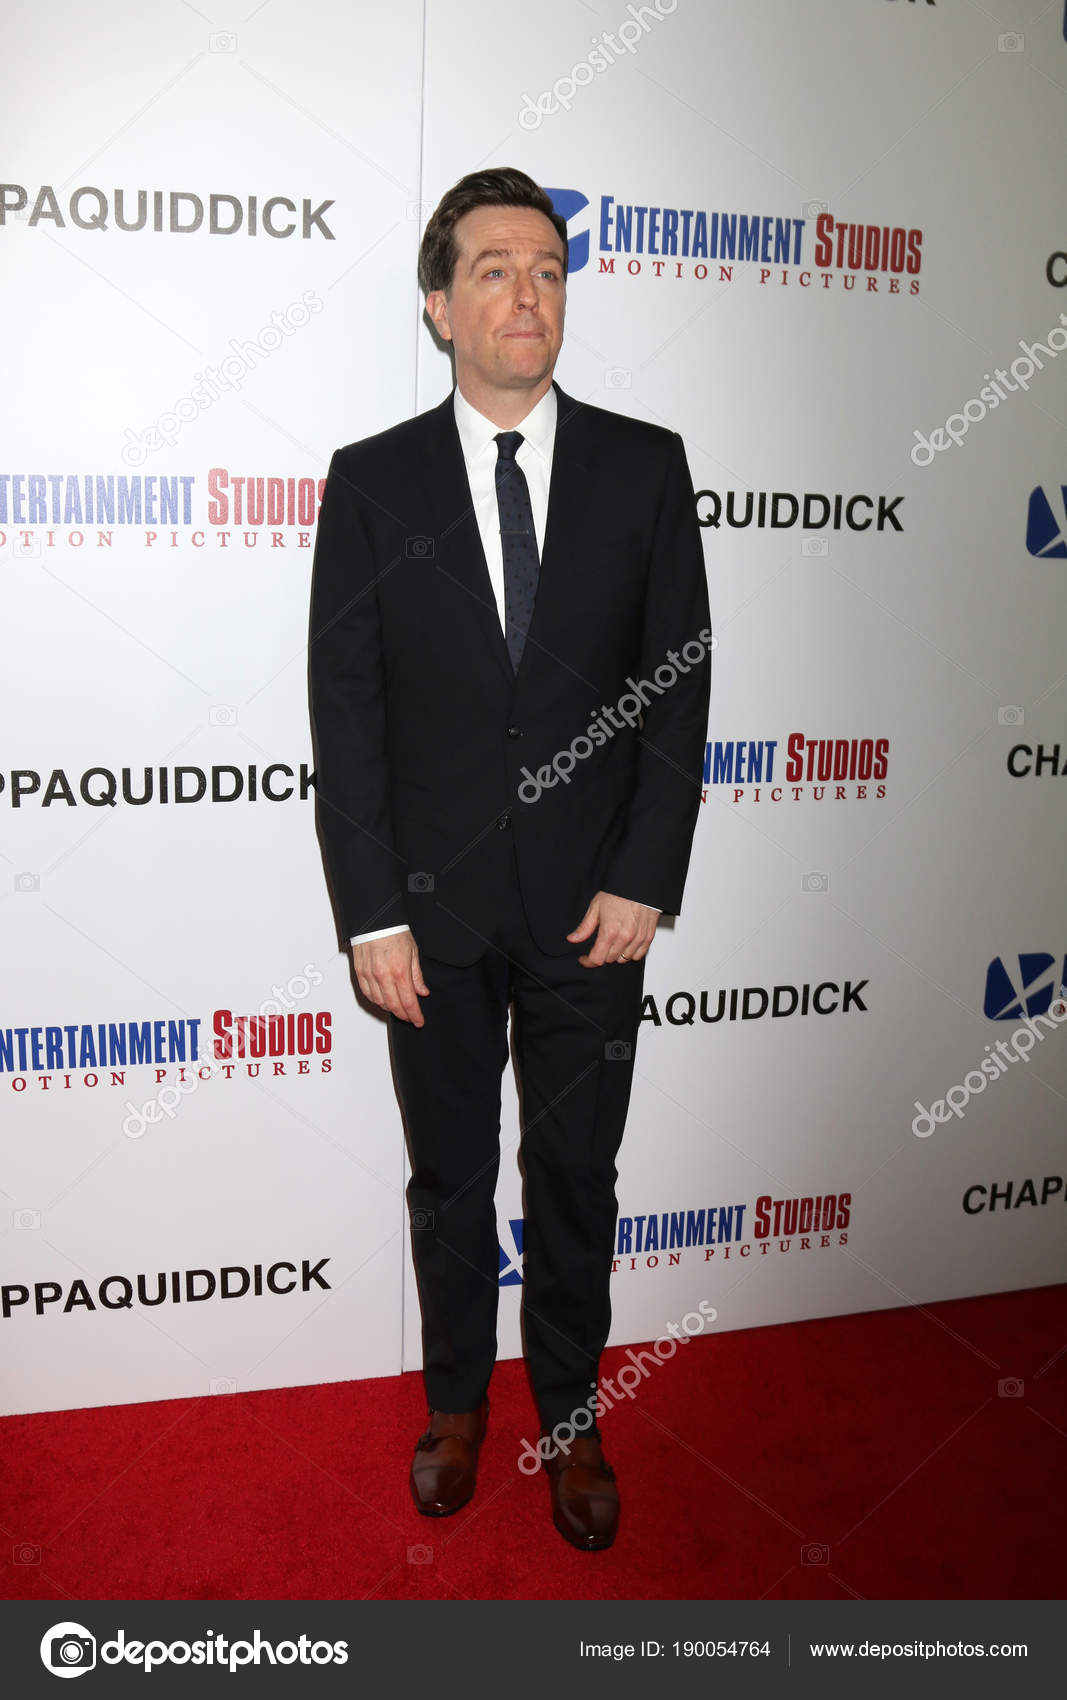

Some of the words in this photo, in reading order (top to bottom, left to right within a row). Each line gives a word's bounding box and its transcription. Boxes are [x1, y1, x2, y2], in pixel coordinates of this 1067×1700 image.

[0, 184, 336, 240] PAQUIDDICK
[599, 195, 806, 265] ENTERTAINMENT
[814, 213, 922, 275] STUDIOS
[598, 258, 734, 281] MOTION
[759, 268, 920, 295] PICTURES
[695, 489, 905, 532] QUIDDICK
[145, 531, 311, 548] PICTURE
[786, 732, 890, 782] STUDIOS
[1007, 744, 1067, 777] CH
[0, 764, 317, 808] PAQUIDDICK
[733, 784, 886, 803] PICTURES
[640, 980, 869, 1026] AQUIDDICK
[213, 1009, 332, 1060] STUDIOS
[12, 1072, 126, 1091] OTION
[154, 1059, 333, 1083] PICTURES
[754, 1193, 852, 1240] STUDIOS
[962, 1176, 1067, 1214] CHAP
[704, 1233, 849, 1261] PICTURES
[1, 1258, 332, 1318] PPAQUIDDICK
